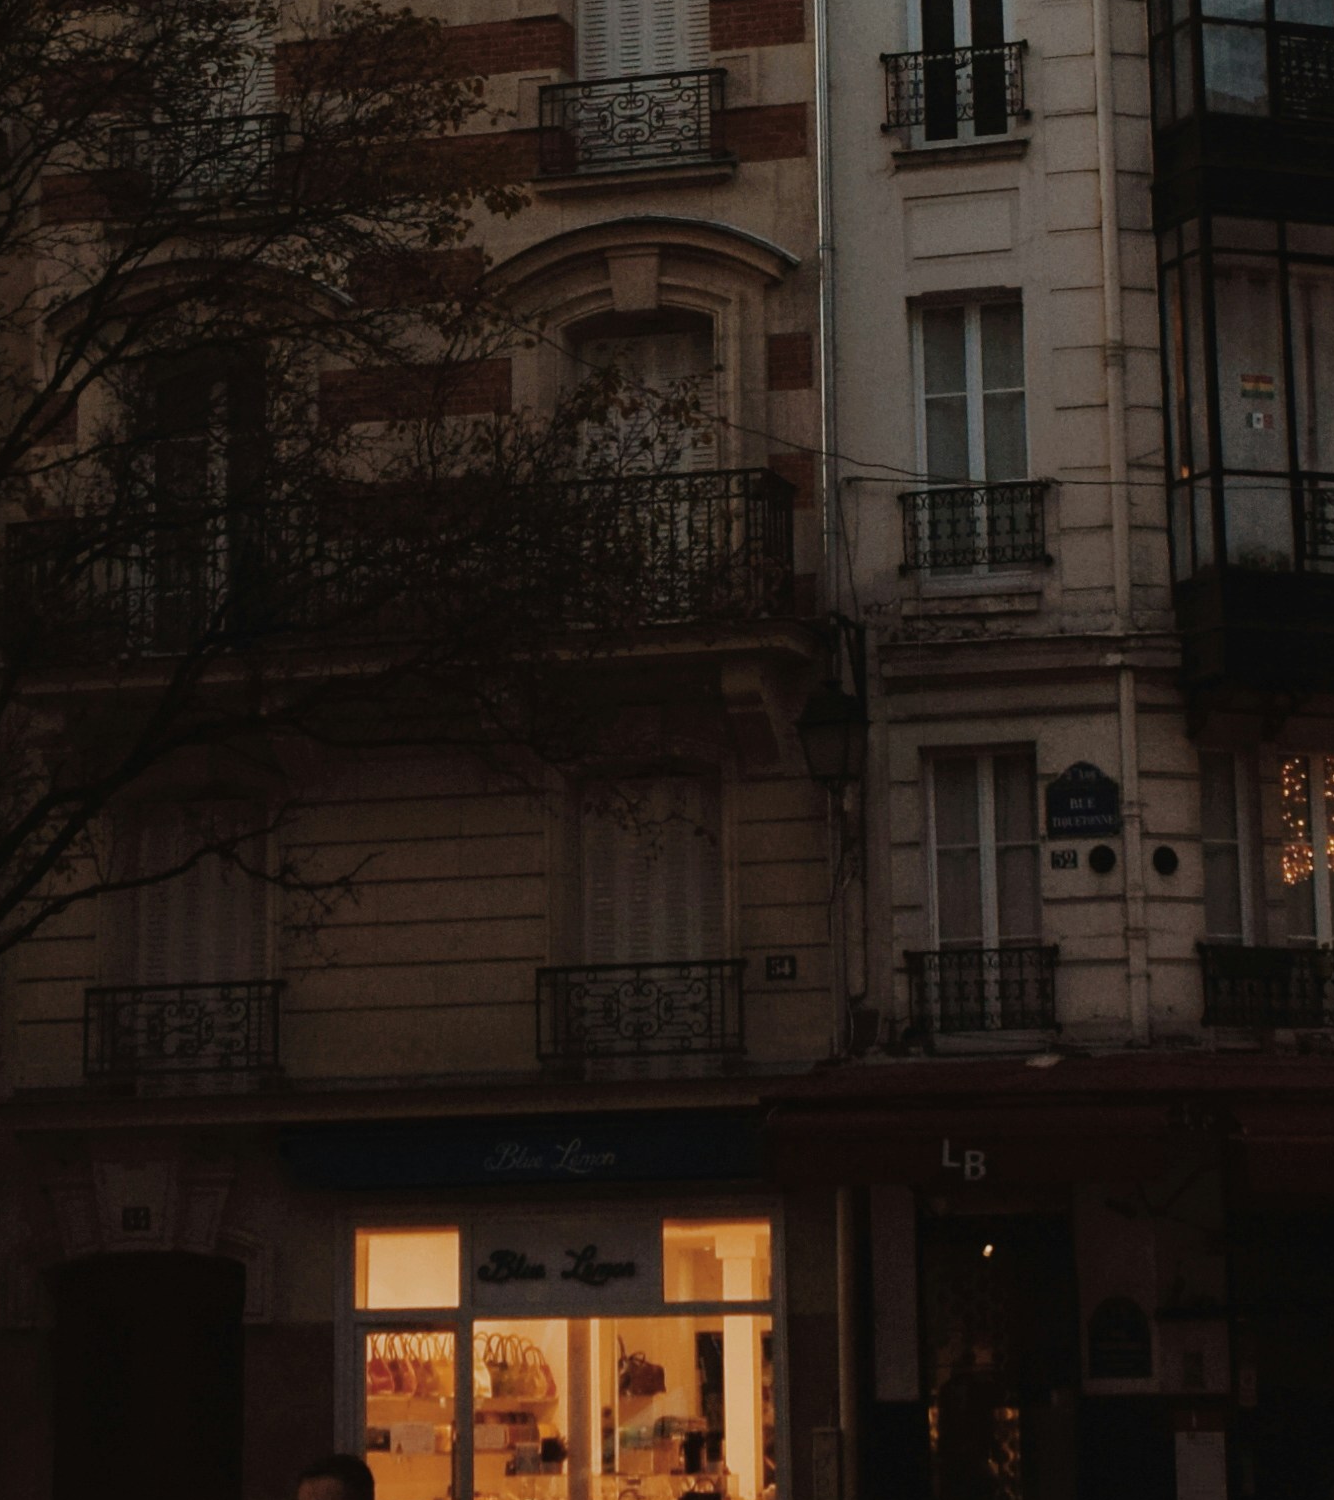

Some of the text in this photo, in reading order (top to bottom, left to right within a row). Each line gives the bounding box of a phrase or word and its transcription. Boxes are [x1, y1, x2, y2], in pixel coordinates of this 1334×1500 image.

[1069, 797, 1097, 810] RUE
[1052, 814, 1114, 828] TIQUETONNE
[1053, 850, 1075, 869] 52
[483, 1137, 616, 1174] Blue Lemon
[477, 1244, 636, 1286] Blue Lemon
